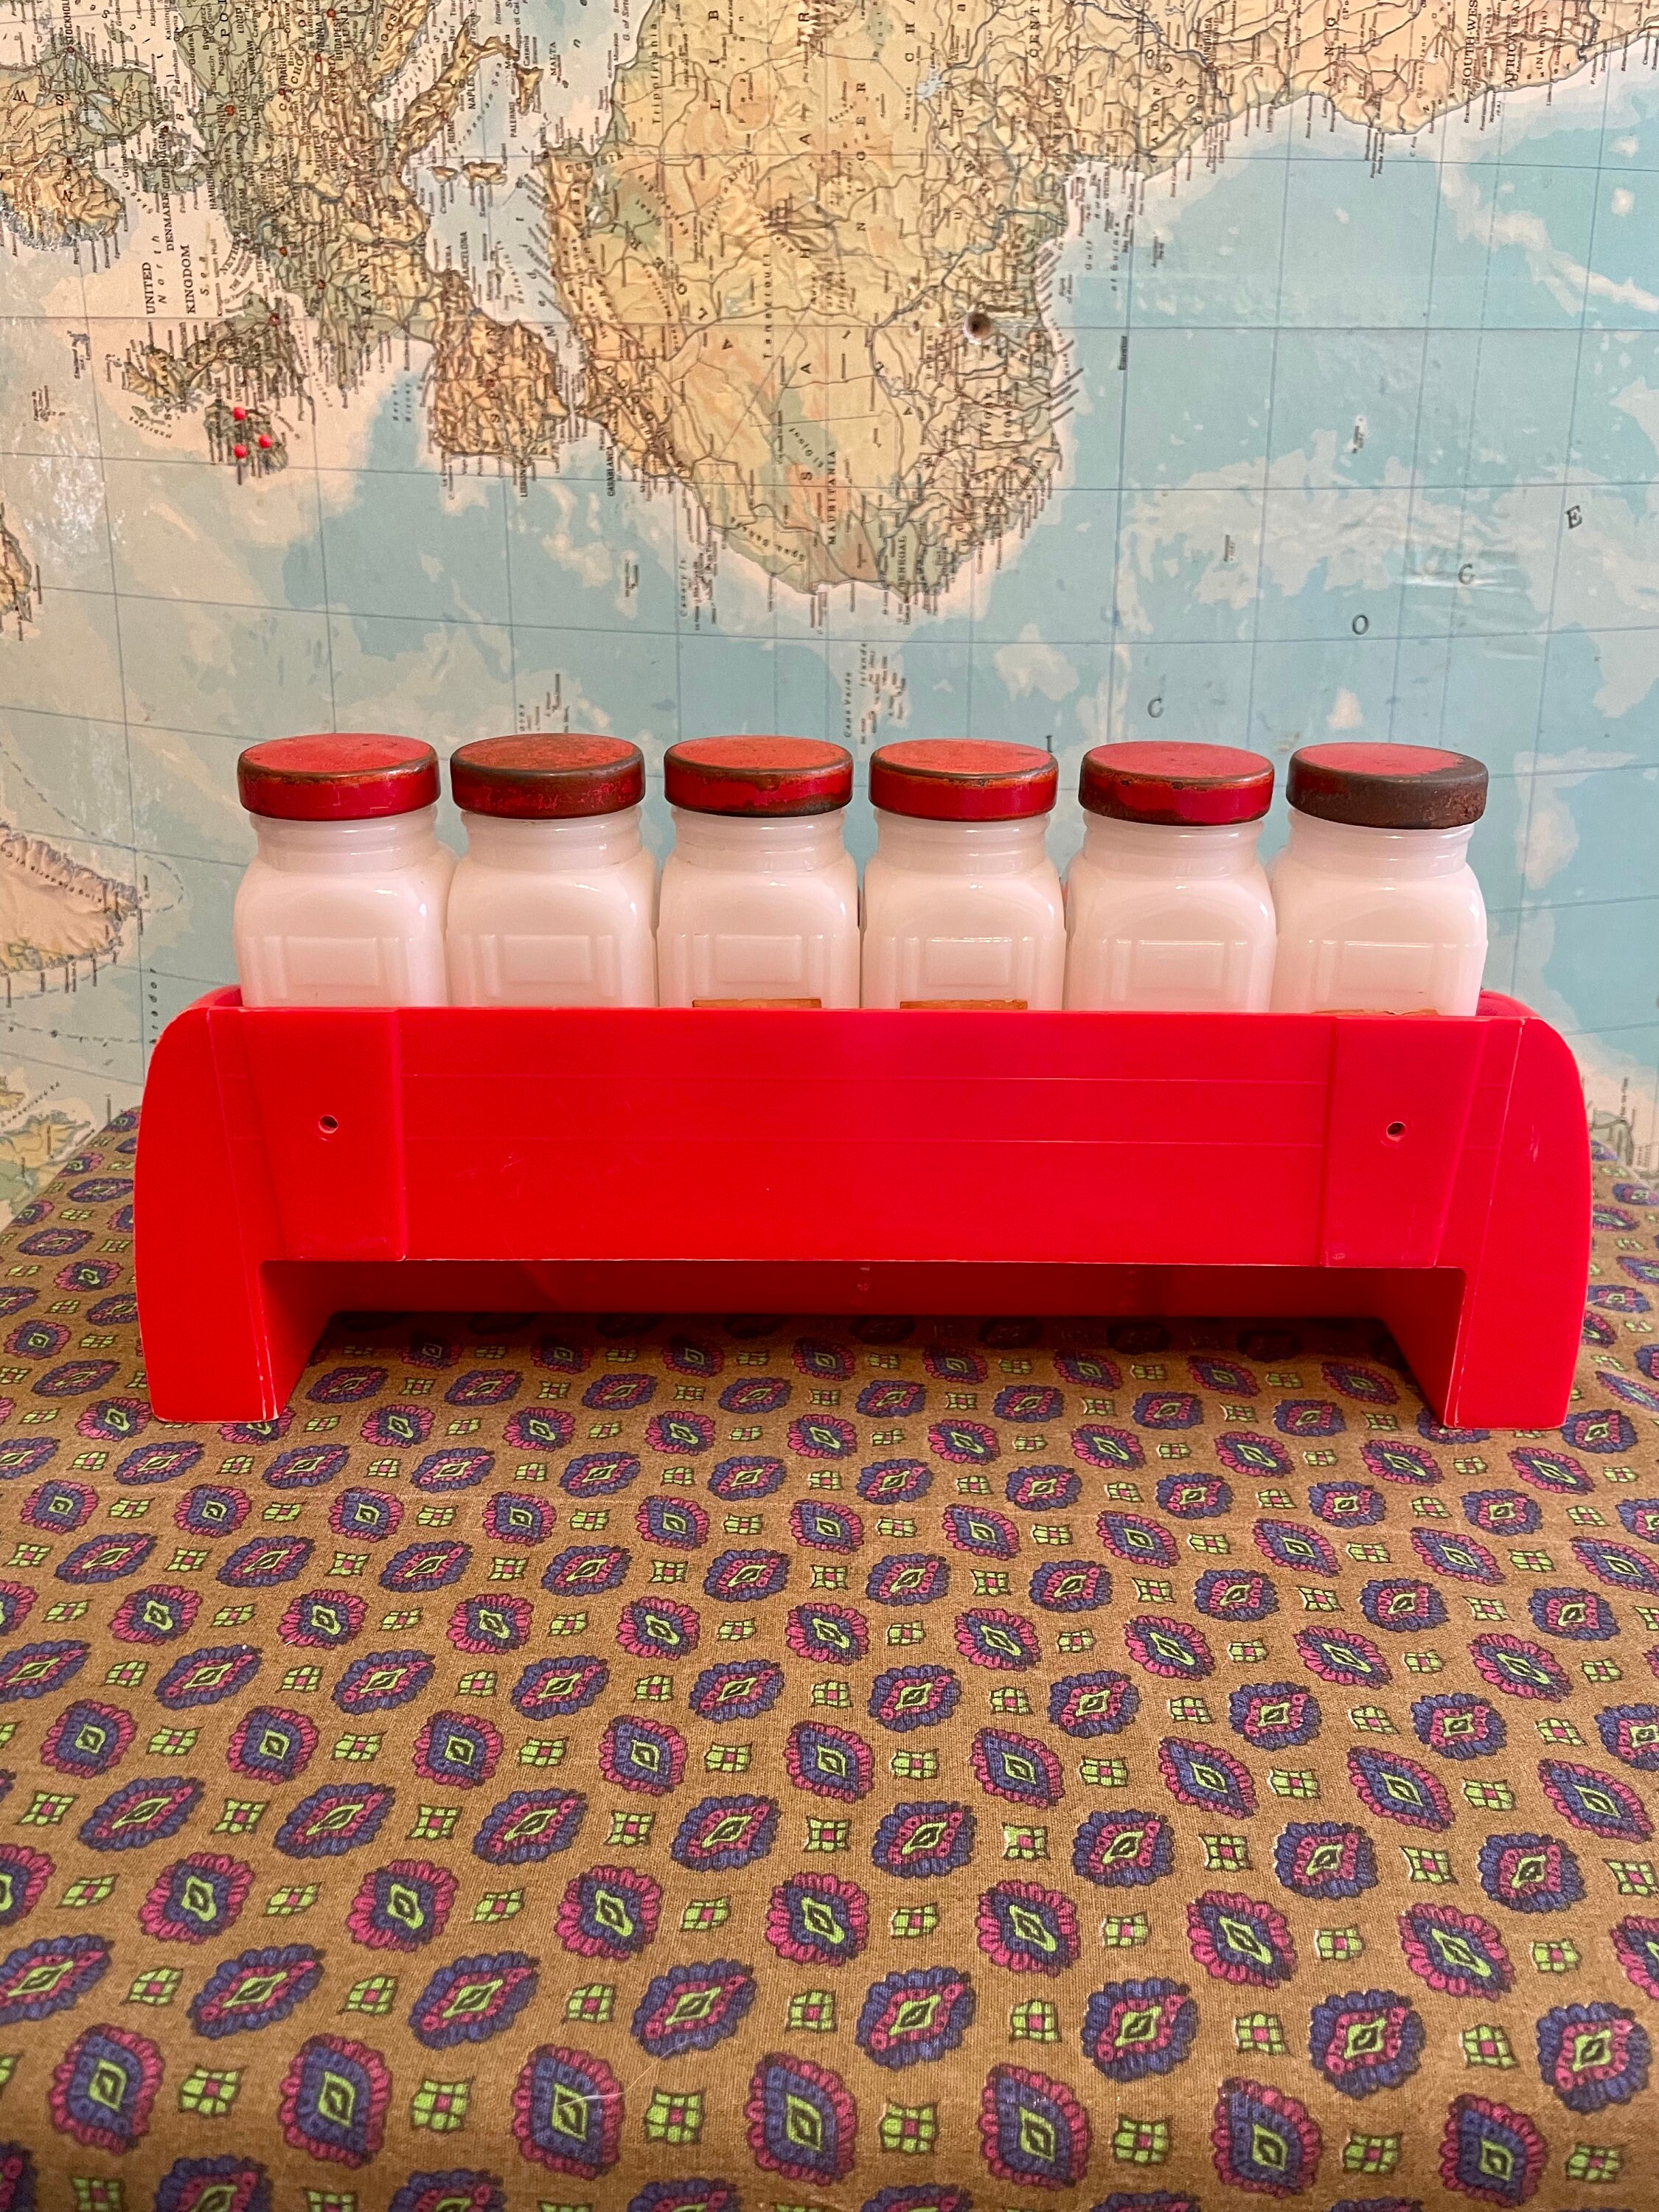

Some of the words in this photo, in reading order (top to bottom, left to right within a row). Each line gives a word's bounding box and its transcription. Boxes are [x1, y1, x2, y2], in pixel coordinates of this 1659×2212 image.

[62, 0, 74, 45] STOCKHOL
[316, 21, 325, 52] VIENNA
[333, 17, 344, 61] BUDAPEST
[1203, 17, 1213, 61] KINSHASA
[1461, 0, 1478, 86] SOUTH-WES
[1536, 10, 1548, 70] (Namibia)
[549, 41, 557, 76] MALTA
[649, 23, 662, 124] Tripolitania
[1503, 33, 1517, 87] AFRICA
[215, 103, 226, 133] BERLIN
[466, 77, 476, 110] NAPLES
[508, 101, 517, 138] PALERMO
[447, 120, 456, 143] ROME
[855, 82, 866, 232] NIGER
[158, 133, 171, 189] COPENHAGEN
[206, 167, 218, 209] HAMBURG
[161, 192, 175, 251] DENMARK
[209, 238, 218, 255] Hull
[151, 235, 167, 304] North
[180, 244, 196, 314] KINGDOM
[198, 256, 209, 296] Sea
[459, 232, 470, 281] BARCELONA
[142, 262, 156, 315] UNITED
[355, 242, 374, 330] FRANCE
[484, 326, 507, 423] SPAIN
[1118, 335, 1128, 371] Equator
[605, 445, 616, 497] CASABLANCA
[827, 450, 838, 545] MAURITANIA
[896, 535, 907, 588] SENEGAL
